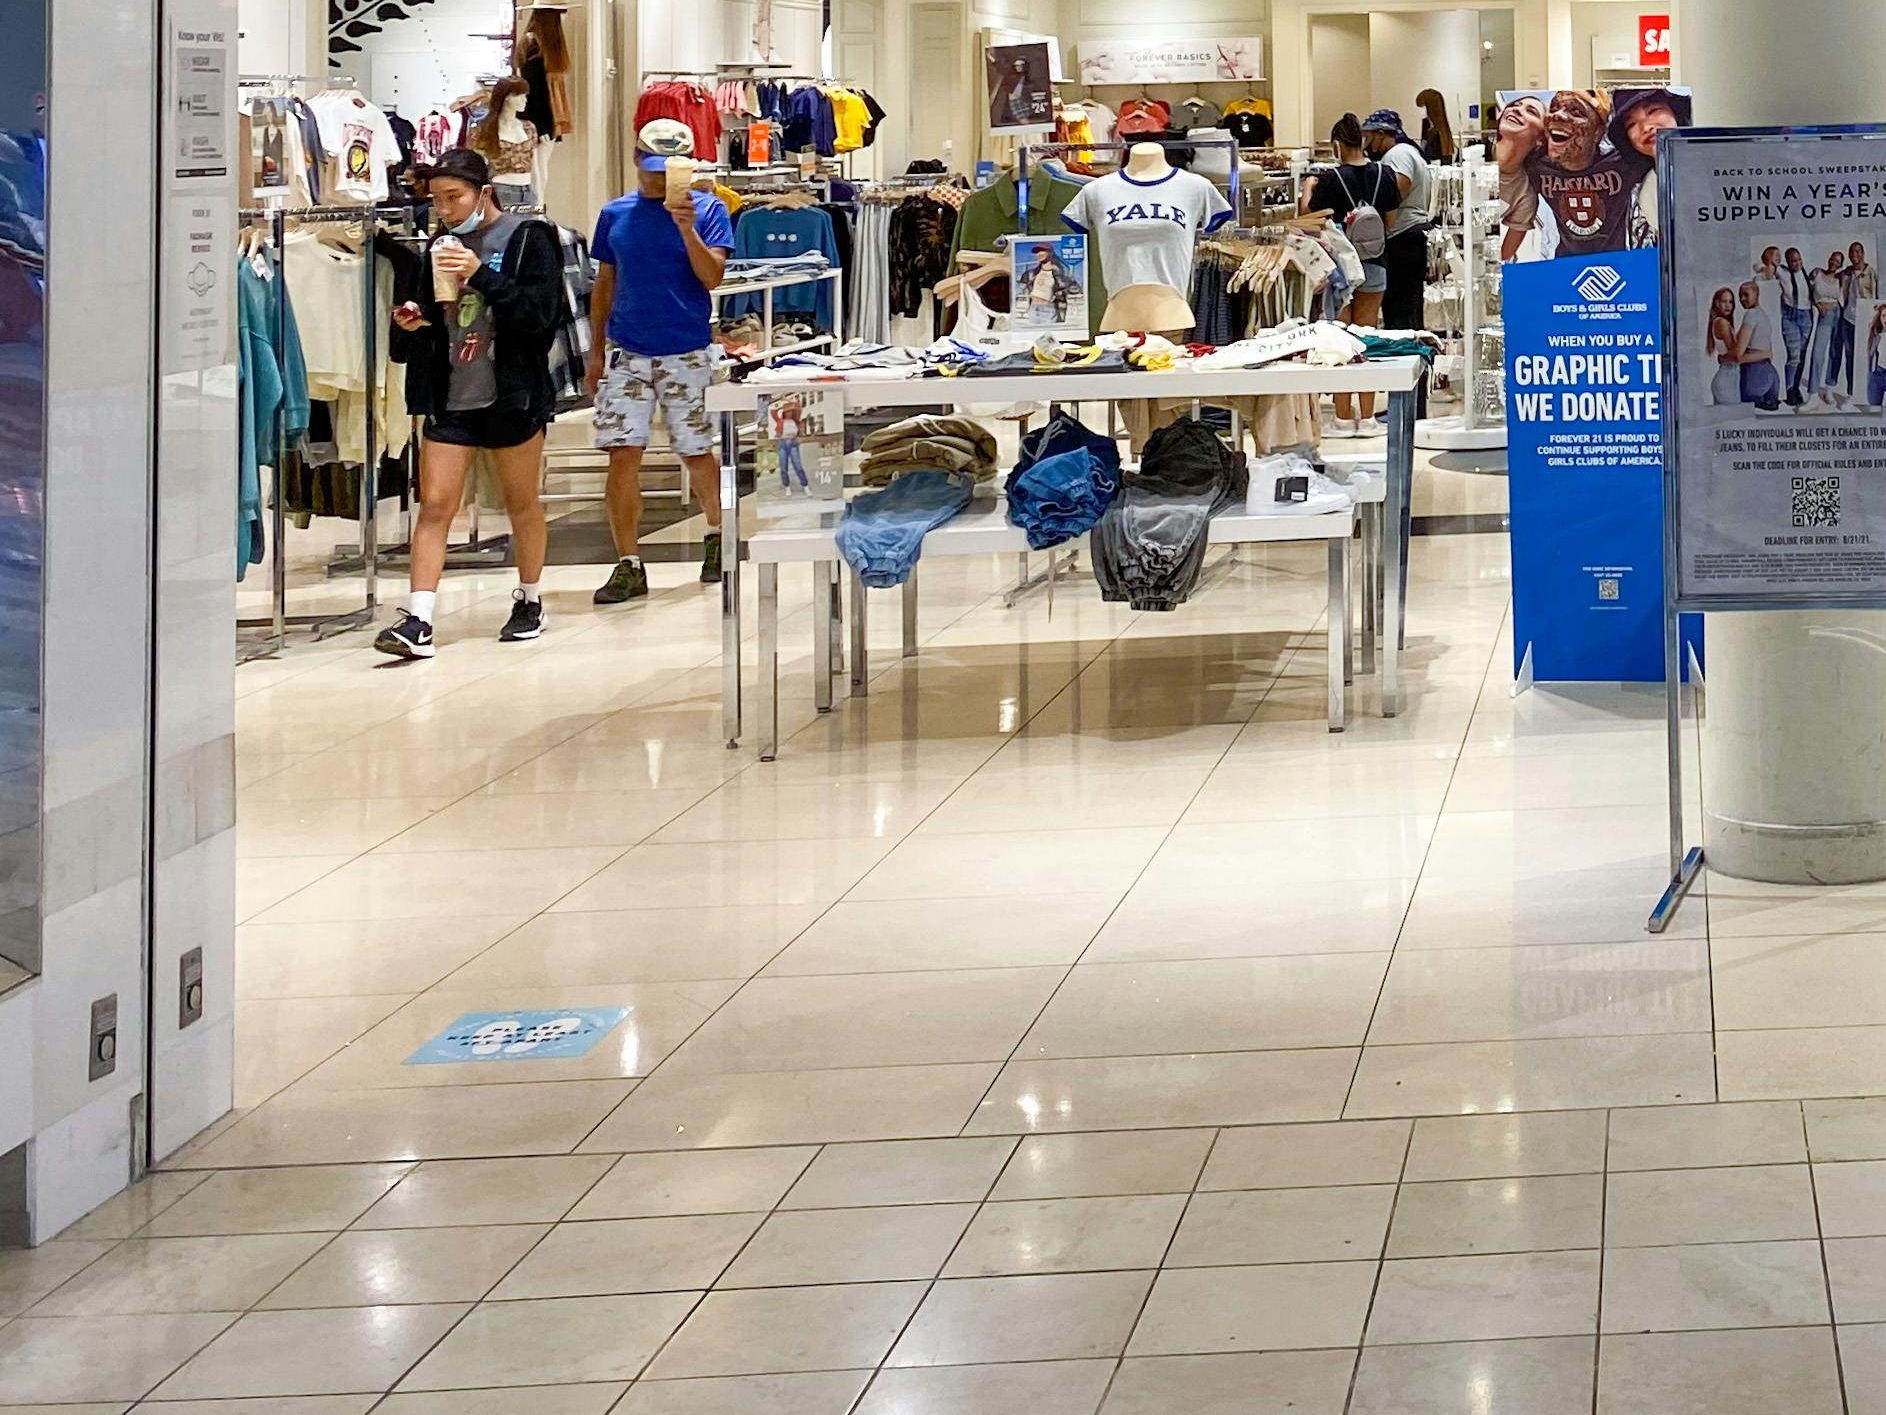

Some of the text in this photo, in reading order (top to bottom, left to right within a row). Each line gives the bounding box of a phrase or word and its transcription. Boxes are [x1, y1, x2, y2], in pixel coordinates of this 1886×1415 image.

[1176, 53, 1212, 61] BASICS
[1714, 168, 1744, 177] BACK
[1748, 168, 1763, 176] TO
[1768, 166, 1814, 175] SCHOOL
[1540, 170, 1623, 198] HARVARD
[1723, 185, 1770, 201] WIN
[1782, 185, 1798, 200] A
[1106, 203, 1186, 229] YALE
[1697, 205, 1790, 222] SUPPLY
[1801, 204, 1832, 219] OF
[1553, 303, 1647, 313] BOYS & GIRLS CLUBS
[1548, 335, 1654, 347] WHEN YOU BUY A
[1515, 354, 1630, 386] GRAPHIC
[1515, 392, 1659, 422] WE DONATE
[1550, 434, 1659, 443] FOREVER 21 IS PROUD TO
[1722, 430, 1745, 439] LUCKY
[1747, 429, 1794, 438] INDIVIDUALS
[1796, 428, 1814, 438] WILL
[1816, 428, 1828, 437] GET
[1831, 428, 1837, 437] A
[1839, 427, 1868, 437] CHANCE
[1869, 427, 1879, 436] TO
[1537, 445, 1663, 455] CONTINUE SUPPORTING BOYS
[1747, 443, 1756, 452] TO
[1758, 442, 1774, 451] FILL
[1775, 441, 1797, 451] THEIR
[1799, 441, 1831, 450] CLOSETS
[1832, 440, 1847, 450] FOR
[1849, 440, 1860, 449] AN
[1548, 458, 1574, 466] GIRLS
[1576, 457, 1605, 466] CLUBS
[1607, 457, 1618, 465] OF
[1733, 462, 1751, 470] SCAN
[1752, 461, 1766, 470] THE
[1767, 460, 1785, 470] CODE
[1787, 460, 1800, 469] FOR
[1802, 460, 1832, 469] OFFICIAL
[1834, 459, 1856, 469] RULES
[1858, 459, 1873, 468] AND
[1764, 536, 1798, 546] DEADLINE
[1800, 536, 1813, 545] FOR
[1815, 536, 1838, 545] ENTRY:
